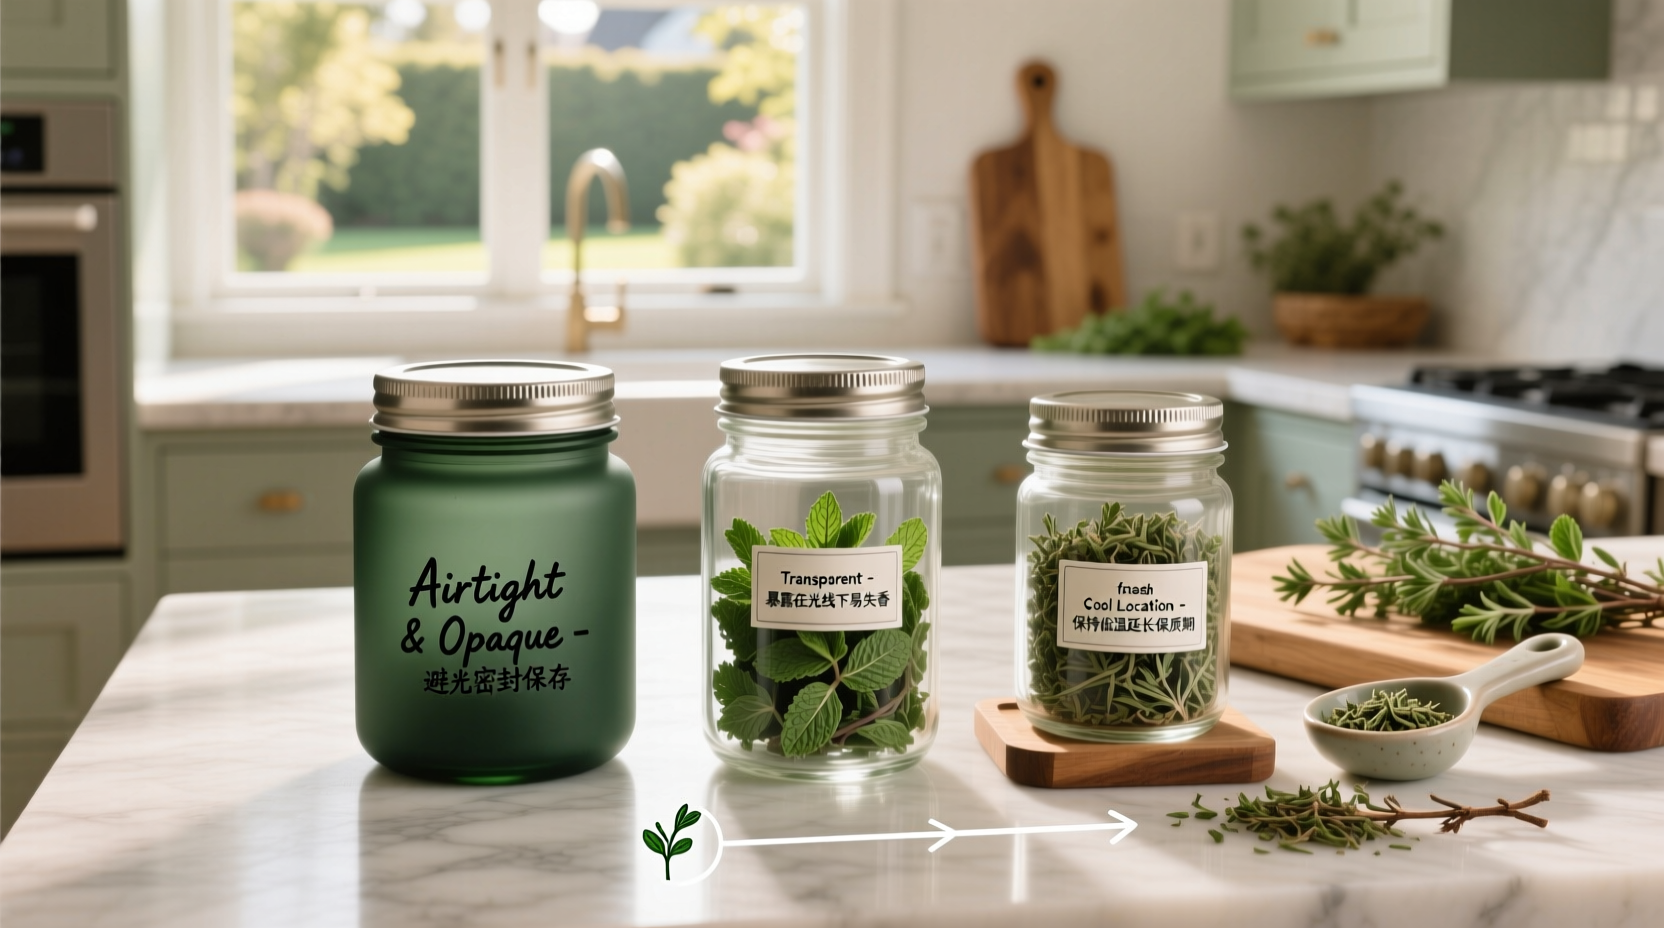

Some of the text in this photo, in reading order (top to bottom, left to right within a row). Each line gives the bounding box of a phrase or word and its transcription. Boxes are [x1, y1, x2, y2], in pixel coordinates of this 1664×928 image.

[408, 557, 566, 623] Airtight
[1083, 597, 1112, 612] Cool
[1117, 599, 1174, 612] Location
[400, 618, 425, 654] &
[439, 615, 564, 668] Opaque
[423, 664, 571, 696] 避光密封保存
